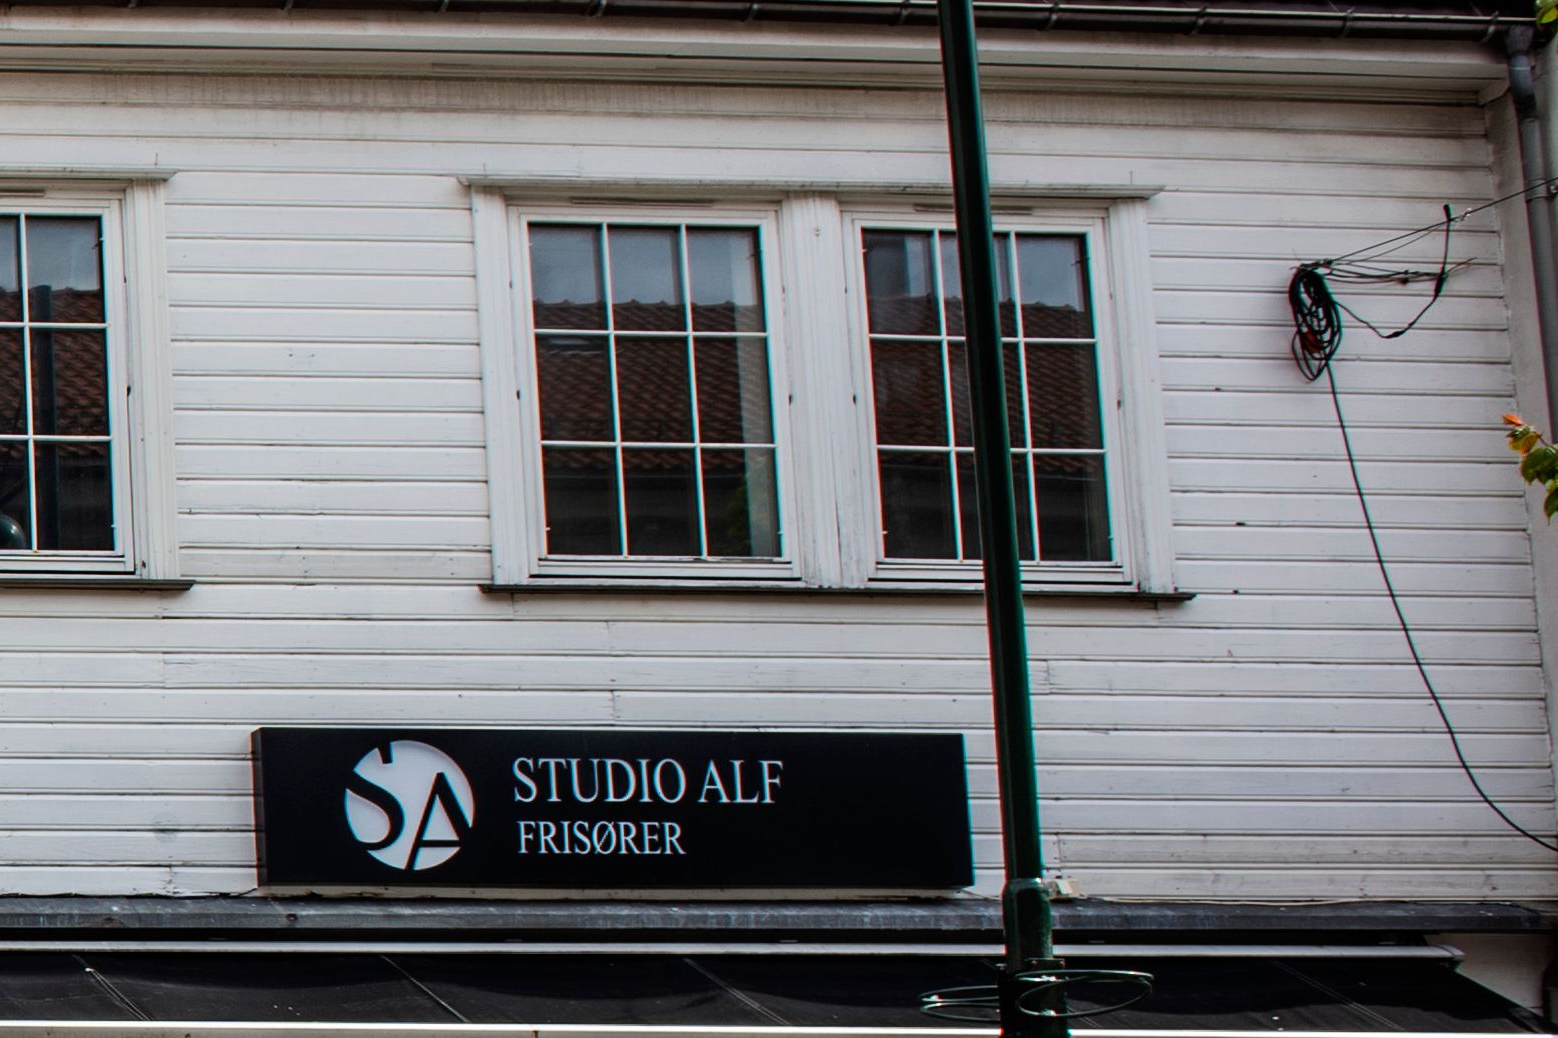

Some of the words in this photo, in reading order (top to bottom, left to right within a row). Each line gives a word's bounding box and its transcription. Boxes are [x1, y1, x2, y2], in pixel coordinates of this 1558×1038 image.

[513, 757, 687, 804] STUDIO
[698, 759, 784, 805] ALF
[517, 820, 687, 856] FRISØRER
